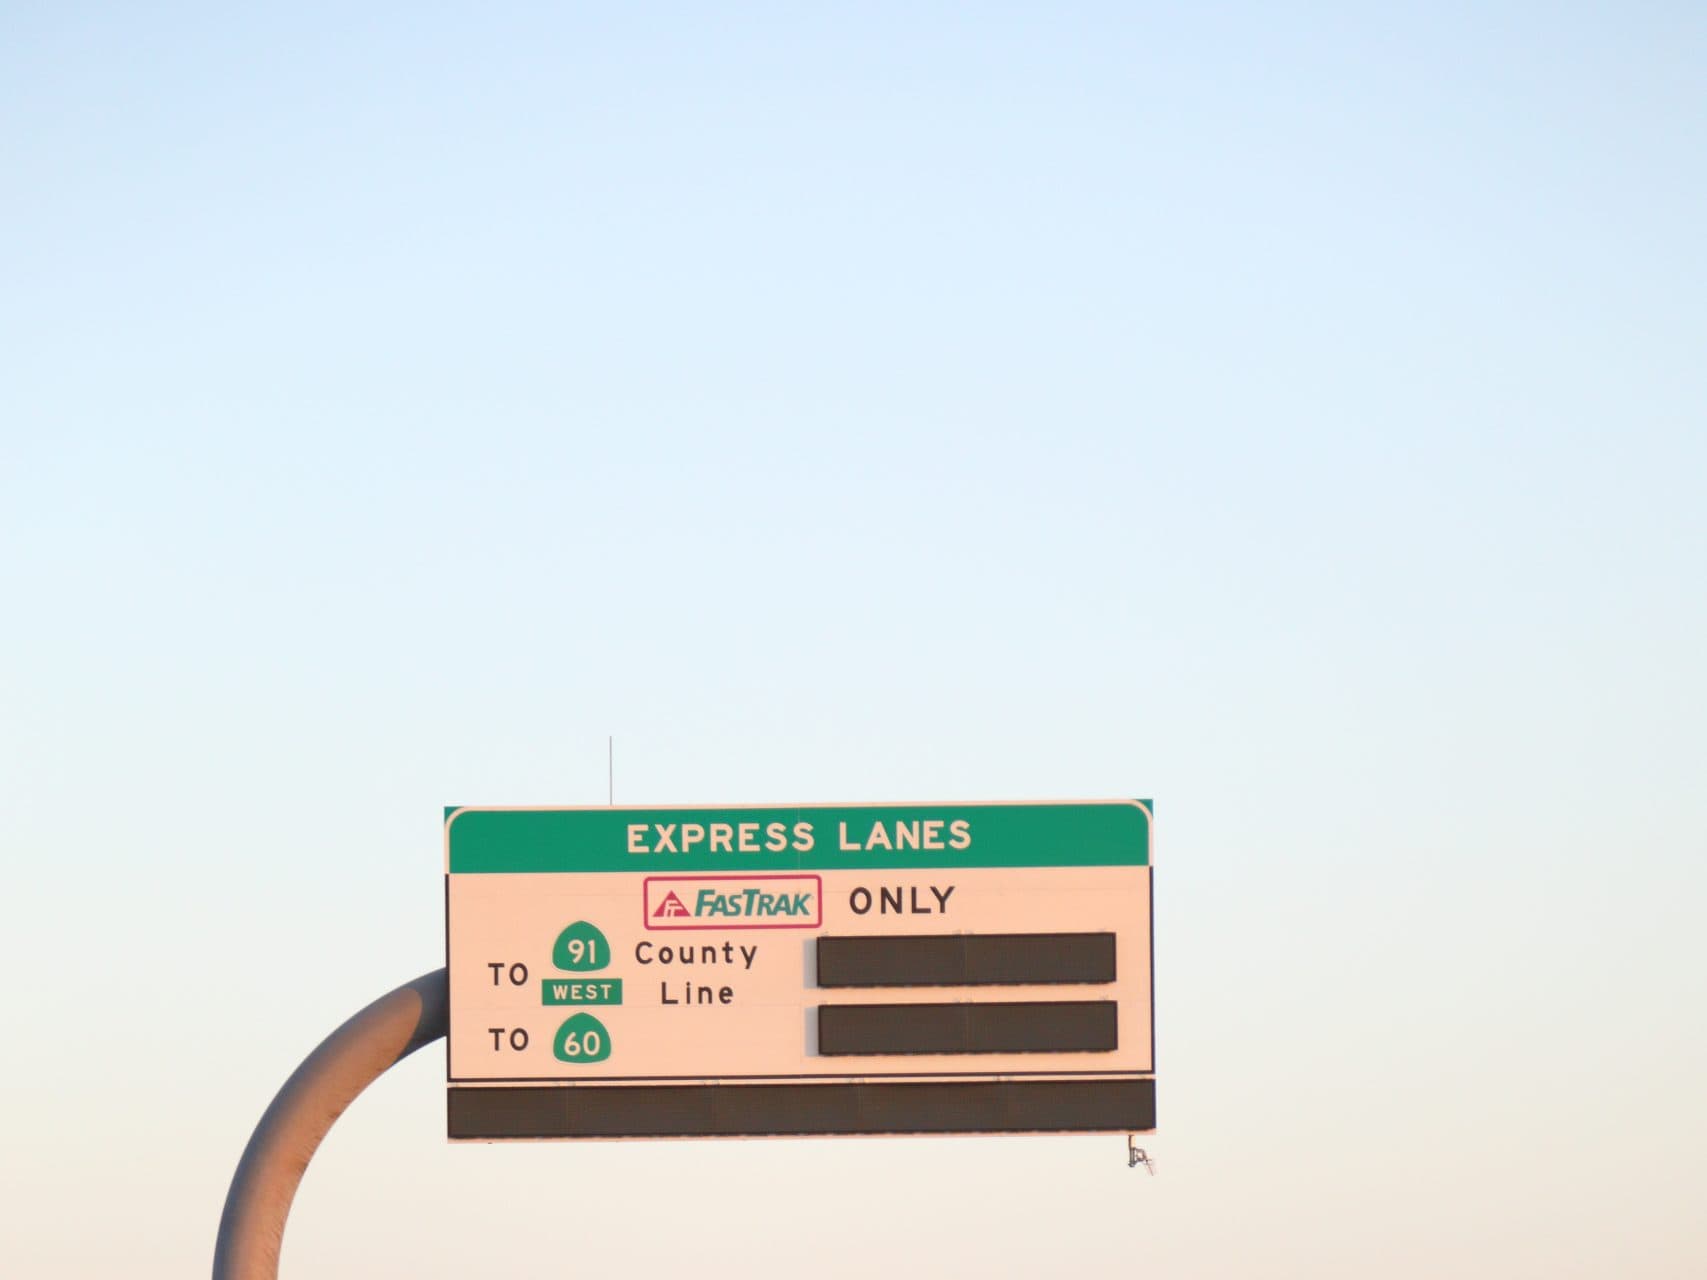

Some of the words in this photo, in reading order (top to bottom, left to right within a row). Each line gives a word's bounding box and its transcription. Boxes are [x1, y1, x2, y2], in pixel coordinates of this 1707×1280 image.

[626, 822, 816, 854] EXPRESS
[838, 819, 972, 851] LANES
[849, 886, 956, 915] ONLY
[567, 938, 597, 965] 91
[635, 940, 758, 970] County
[487, 962, 529, 986] TO
[552, 983, 613, 1001] WEST
[660, 981, 735, 1005] Line
[488, 1027, 530, 1052] TO
[563, 1031, 601, 1056] 60
